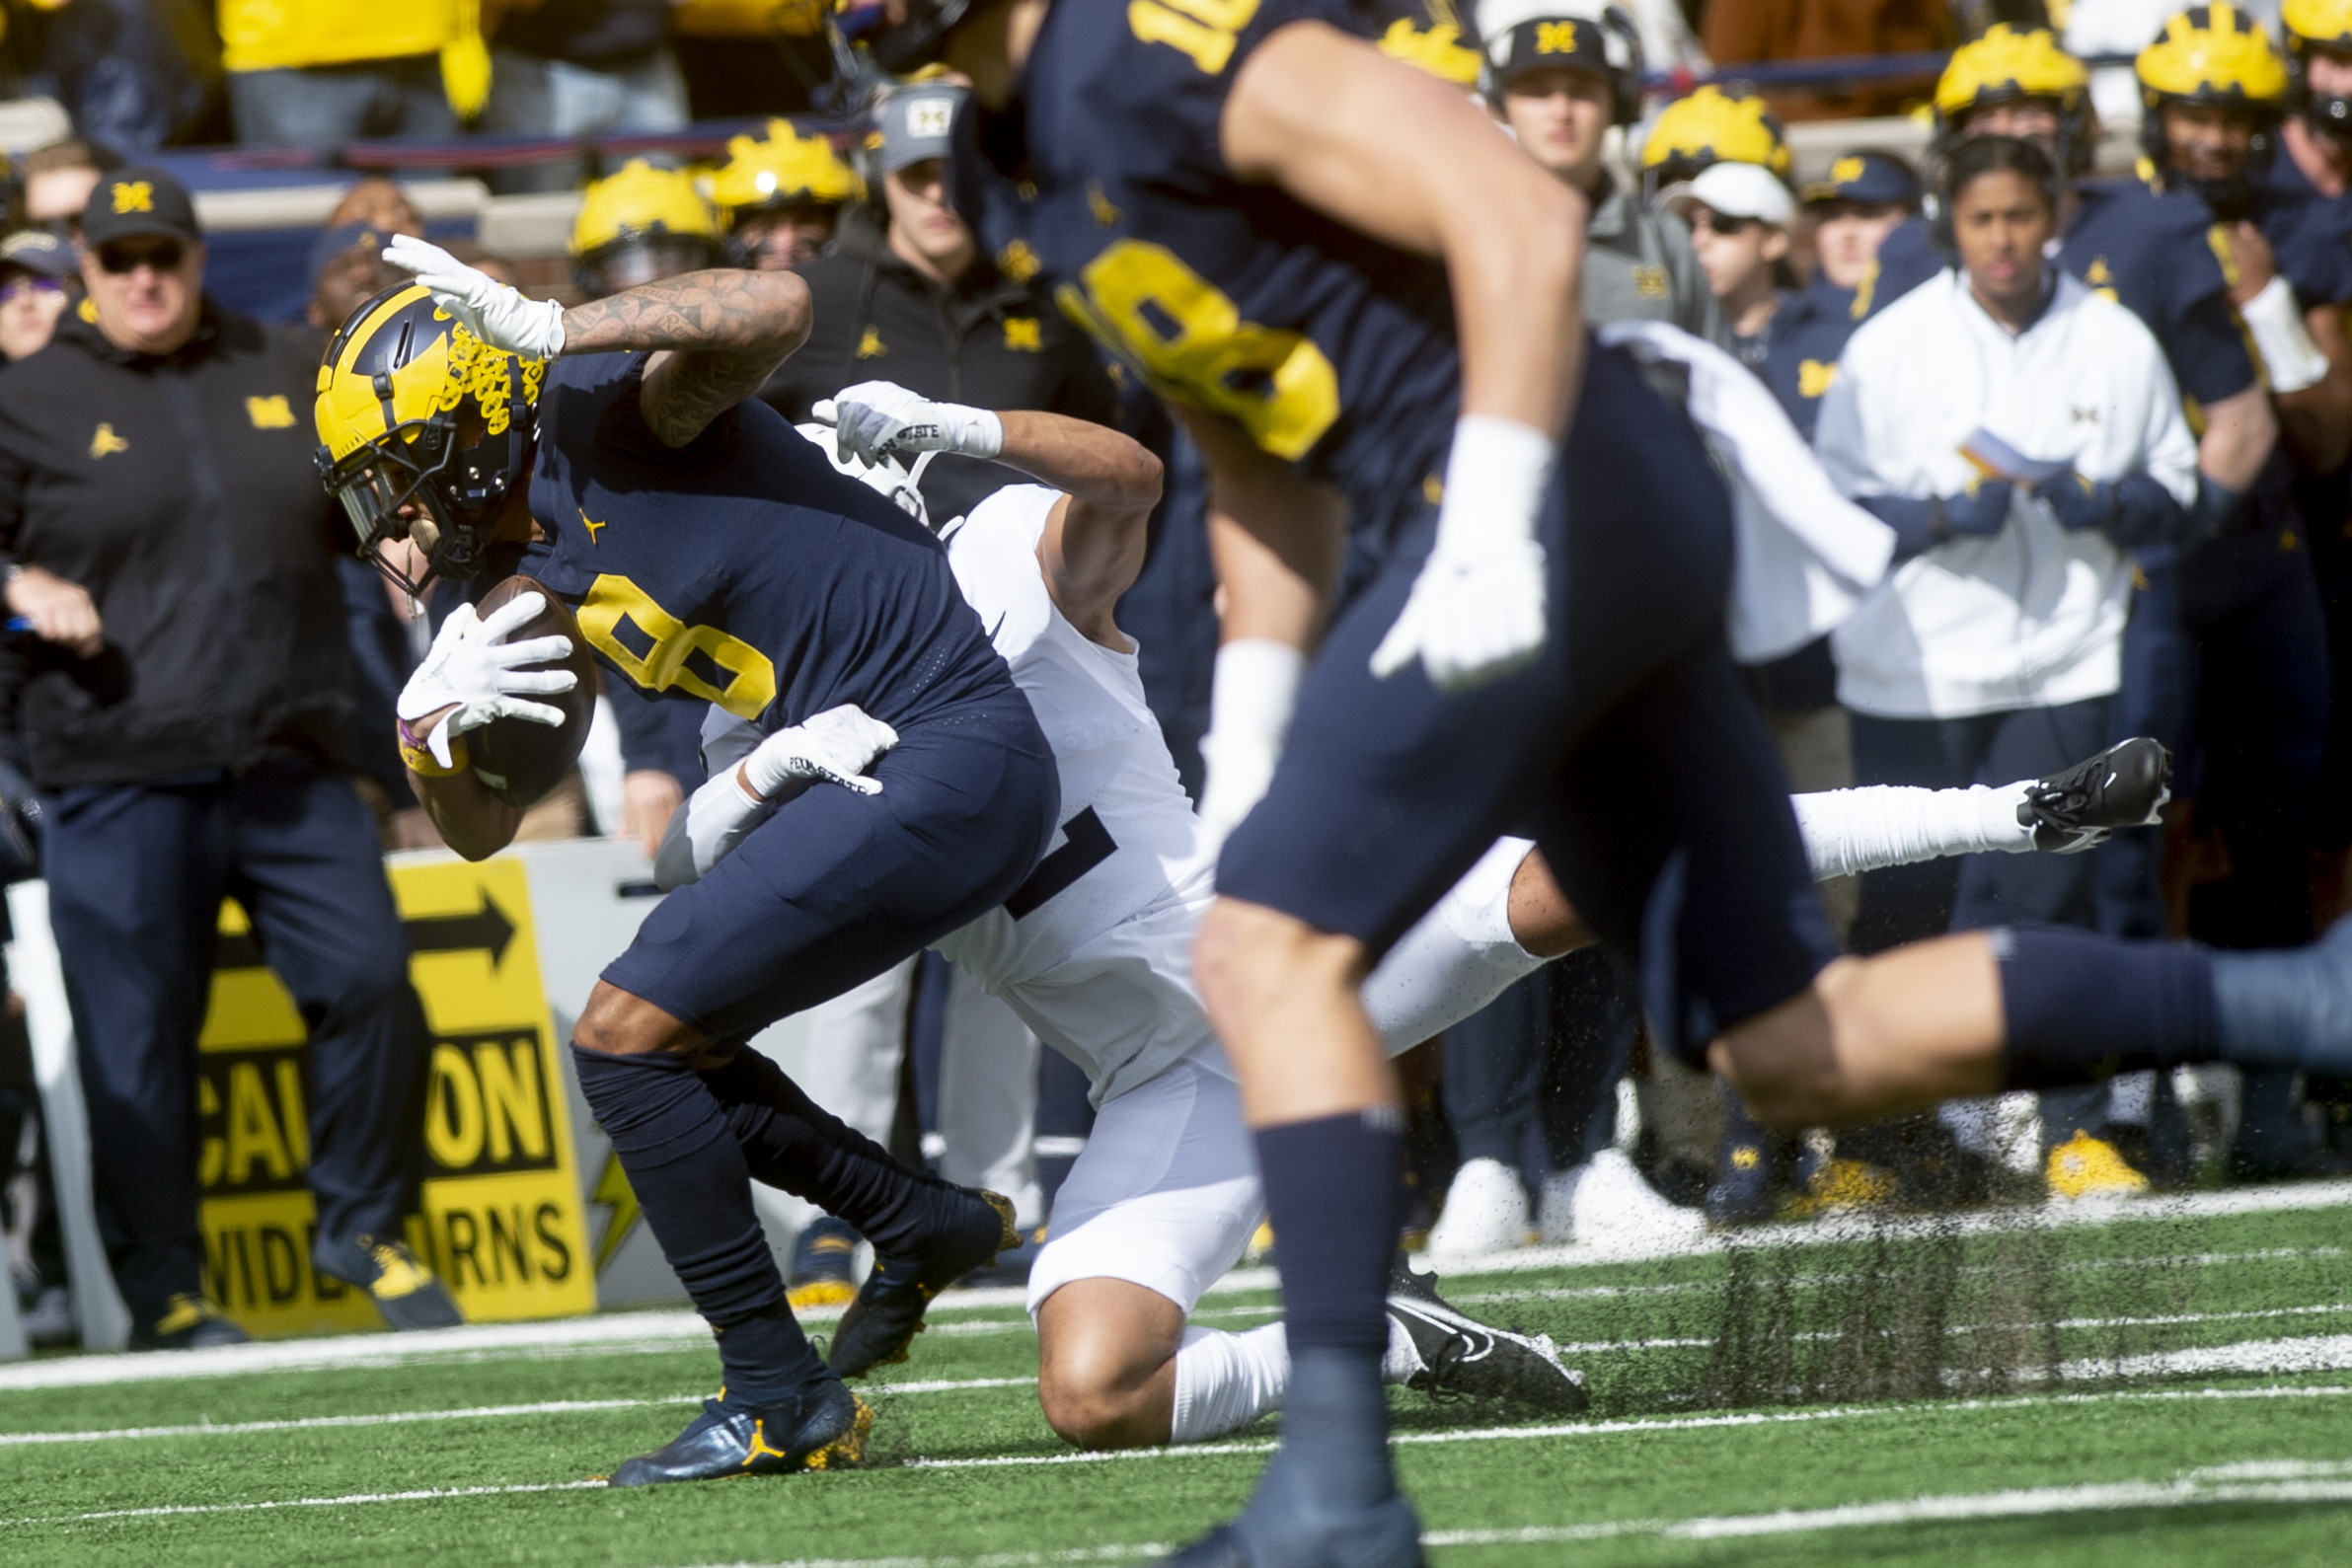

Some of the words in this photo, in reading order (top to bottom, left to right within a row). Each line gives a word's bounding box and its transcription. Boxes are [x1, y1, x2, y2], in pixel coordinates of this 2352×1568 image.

[1535, 20, 1578, 54] M
[111, 180, 155, 214] M
[1003, 317, 1043, 352] M
[245, 395, 298, 428] M
[576, 573, 777, 720] 8
